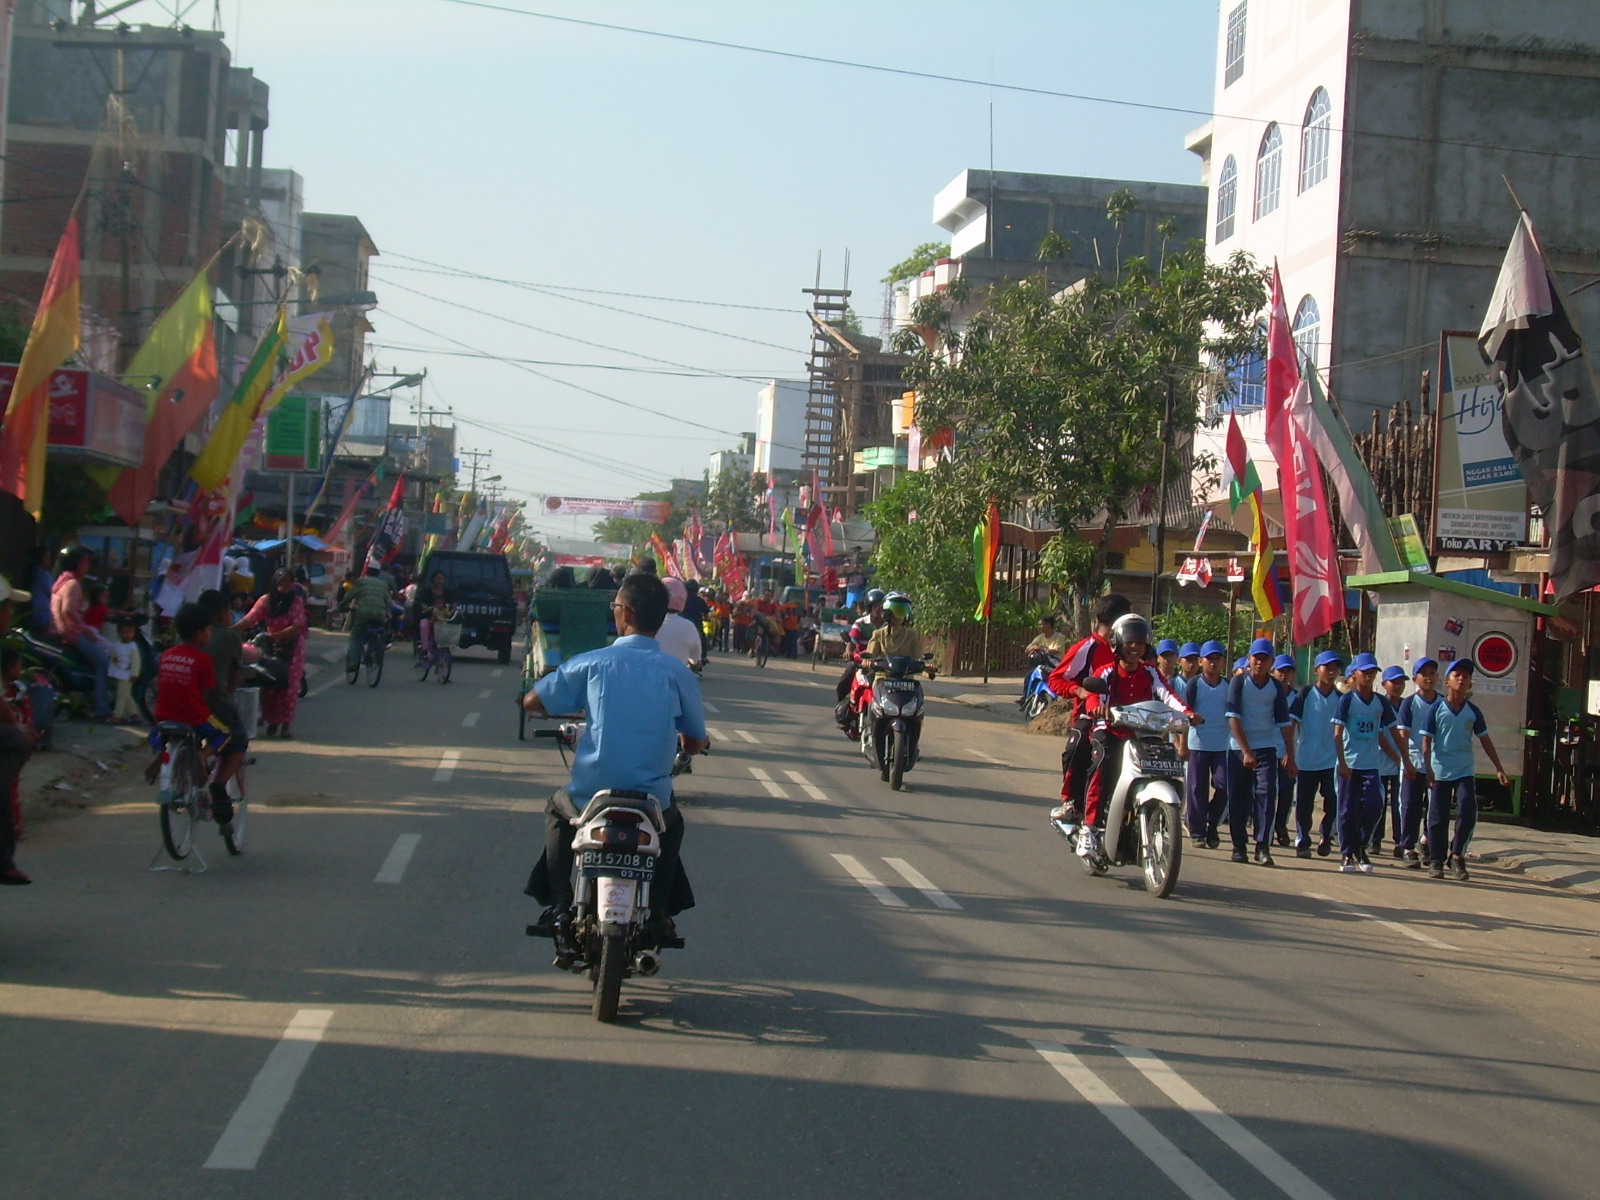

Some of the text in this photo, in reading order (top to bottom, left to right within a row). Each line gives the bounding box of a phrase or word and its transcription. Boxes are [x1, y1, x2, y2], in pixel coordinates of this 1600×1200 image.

[1466, 467, 1491, 475] NGGAK
[1466, 473, 1492, 482] NGGAK
[1441, 537, 1463, 549] Toko
[584, 851, 654, 868] BM 5708 G
